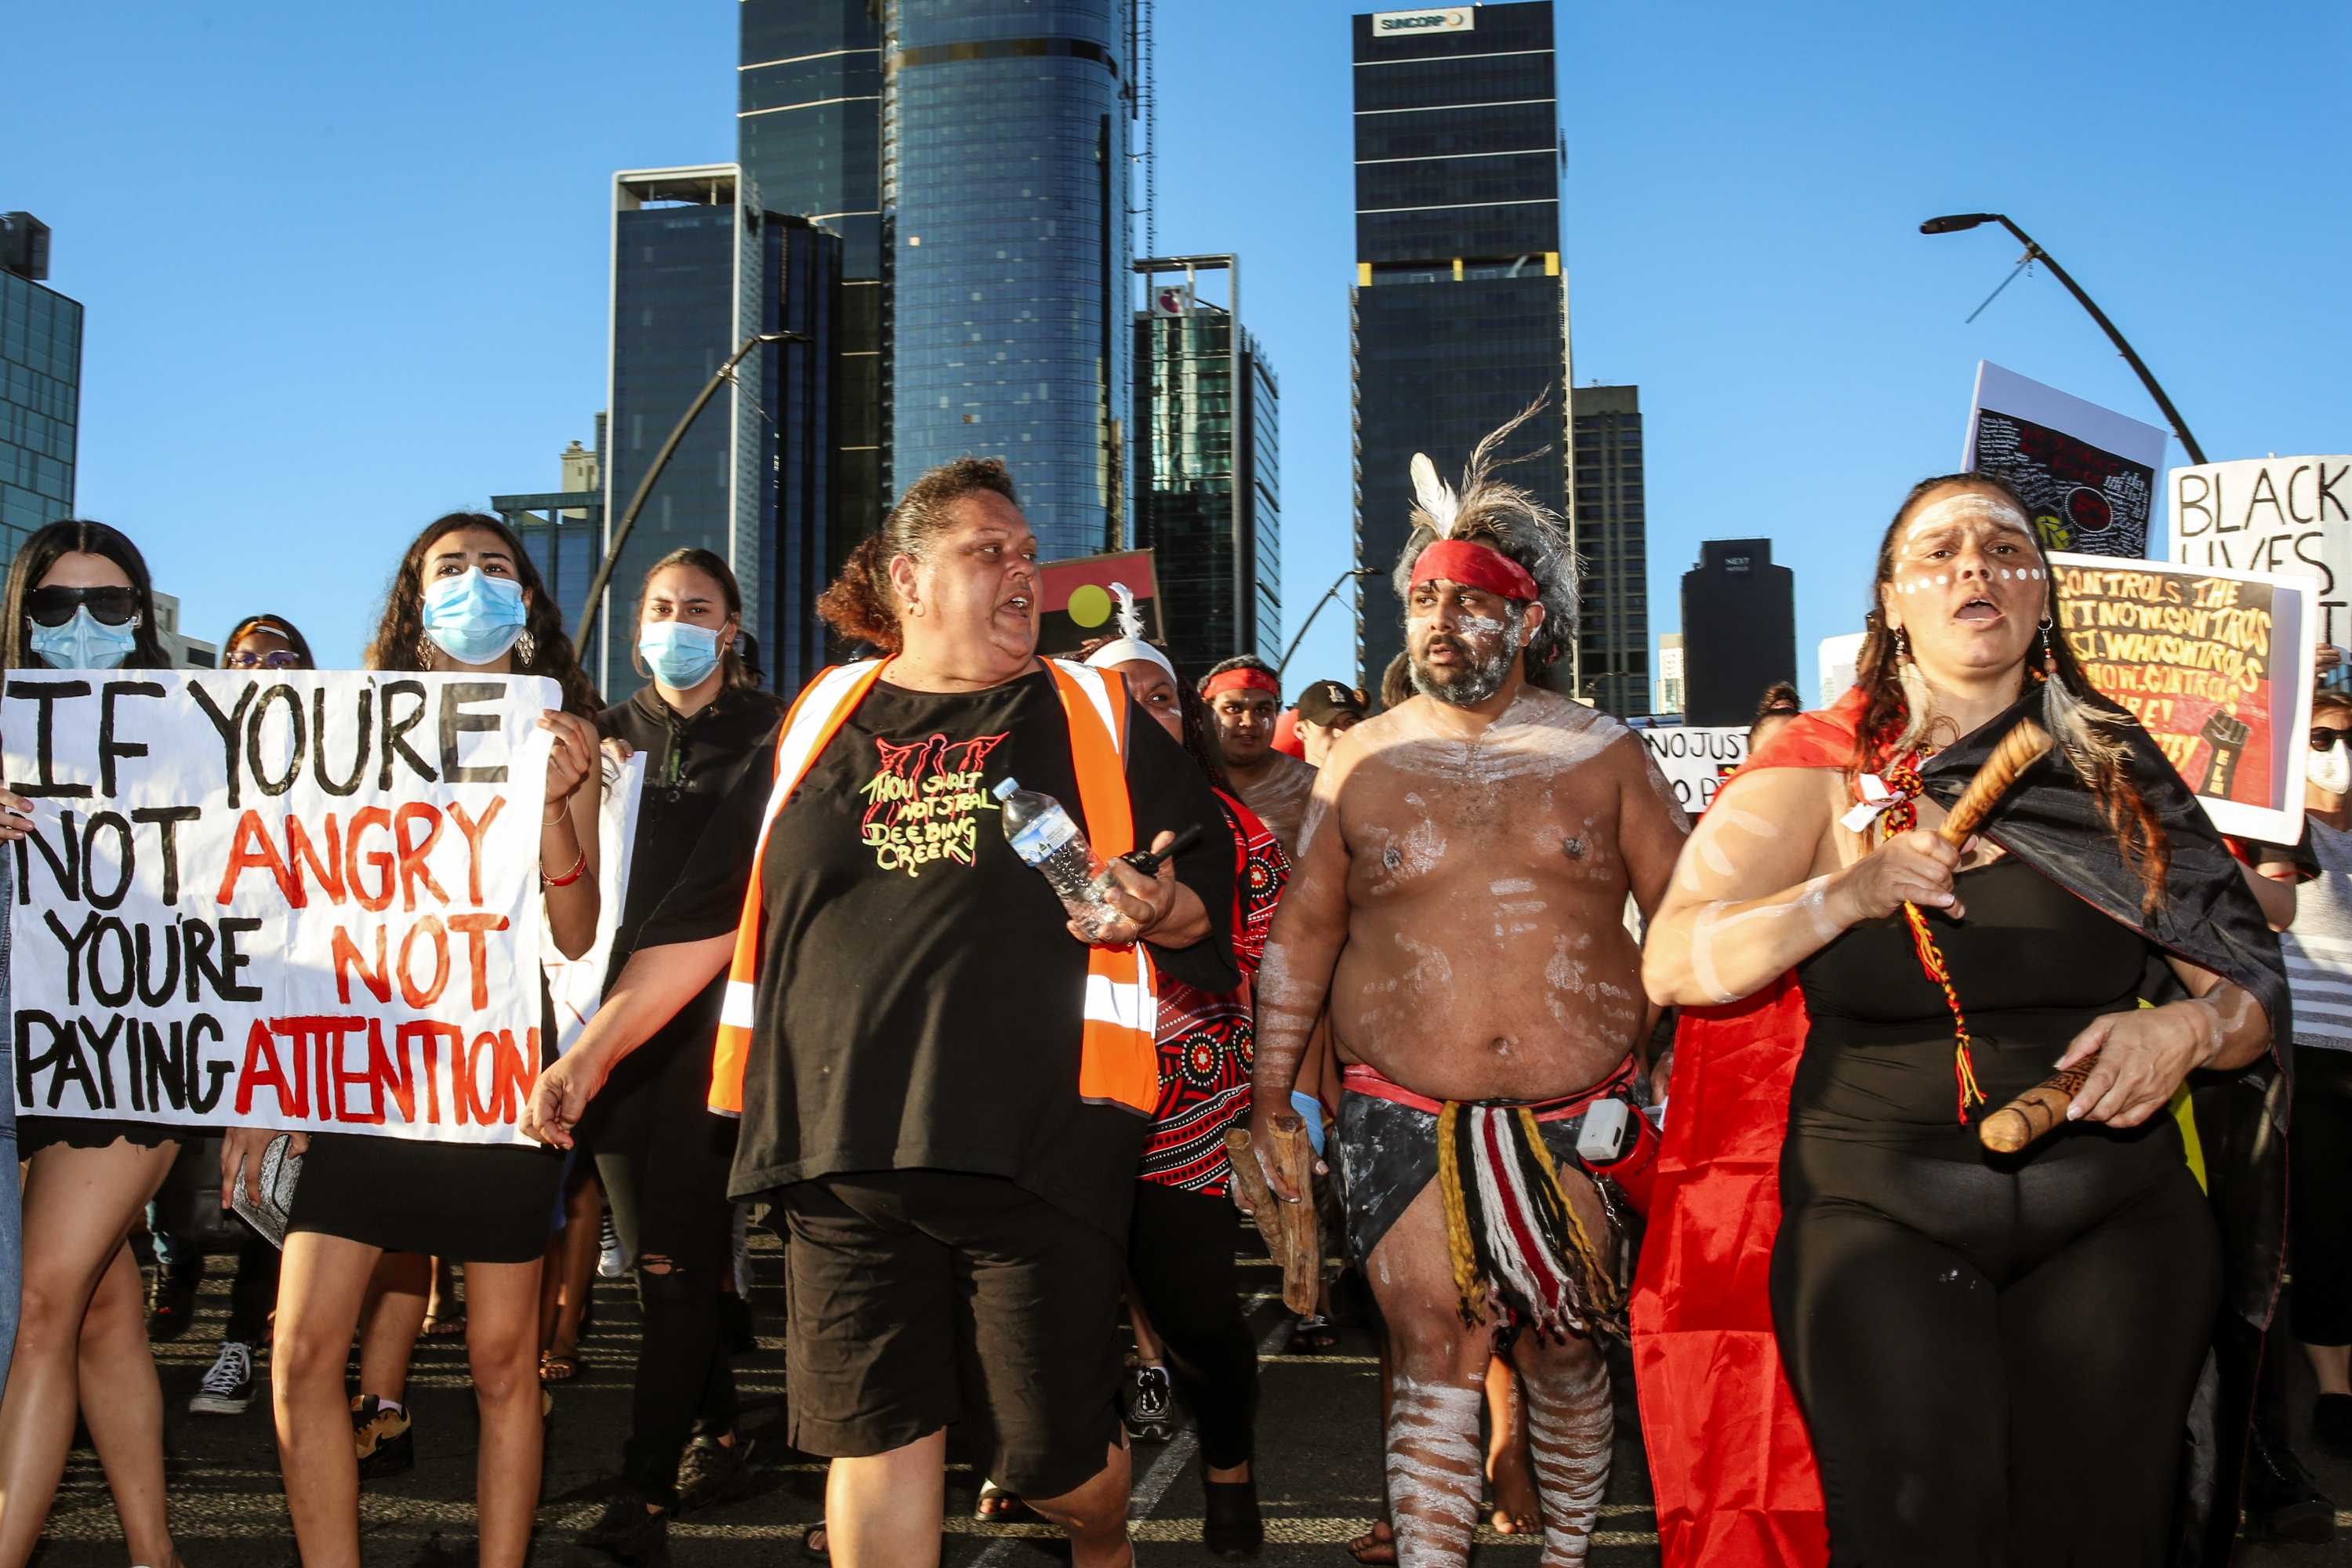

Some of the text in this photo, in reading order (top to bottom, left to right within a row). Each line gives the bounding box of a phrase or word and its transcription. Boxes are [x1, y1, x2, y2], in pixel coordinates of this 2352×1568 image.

[1380, 15, 1445, 30] SUNCORP
[2180, 463, 2350, 537] BLACK
[2052, 565, 2243, 608] CONTROLS THE
[1327, 684, 1346, 703] LA
[7, 681, 165, 798] IF
[187, 676, 508, 808] YOU'RE
[1649, 732, 1750, 760] NO JUS
[859, 770, 984, 805] THOU SHALT
[897, 788, 1000, 821] NOT STEAL
[10, 795, 506, 912] NOT ANGRY
[862, 816, 978, 851] DEEBING
[877, 837, 971, 878] CREEK
[43, 913, 263, 1007] YOU'RE
[332, 913, 509, 1011] NOT
[14, 1010, 540, 1126] PAYING ATTENTION
